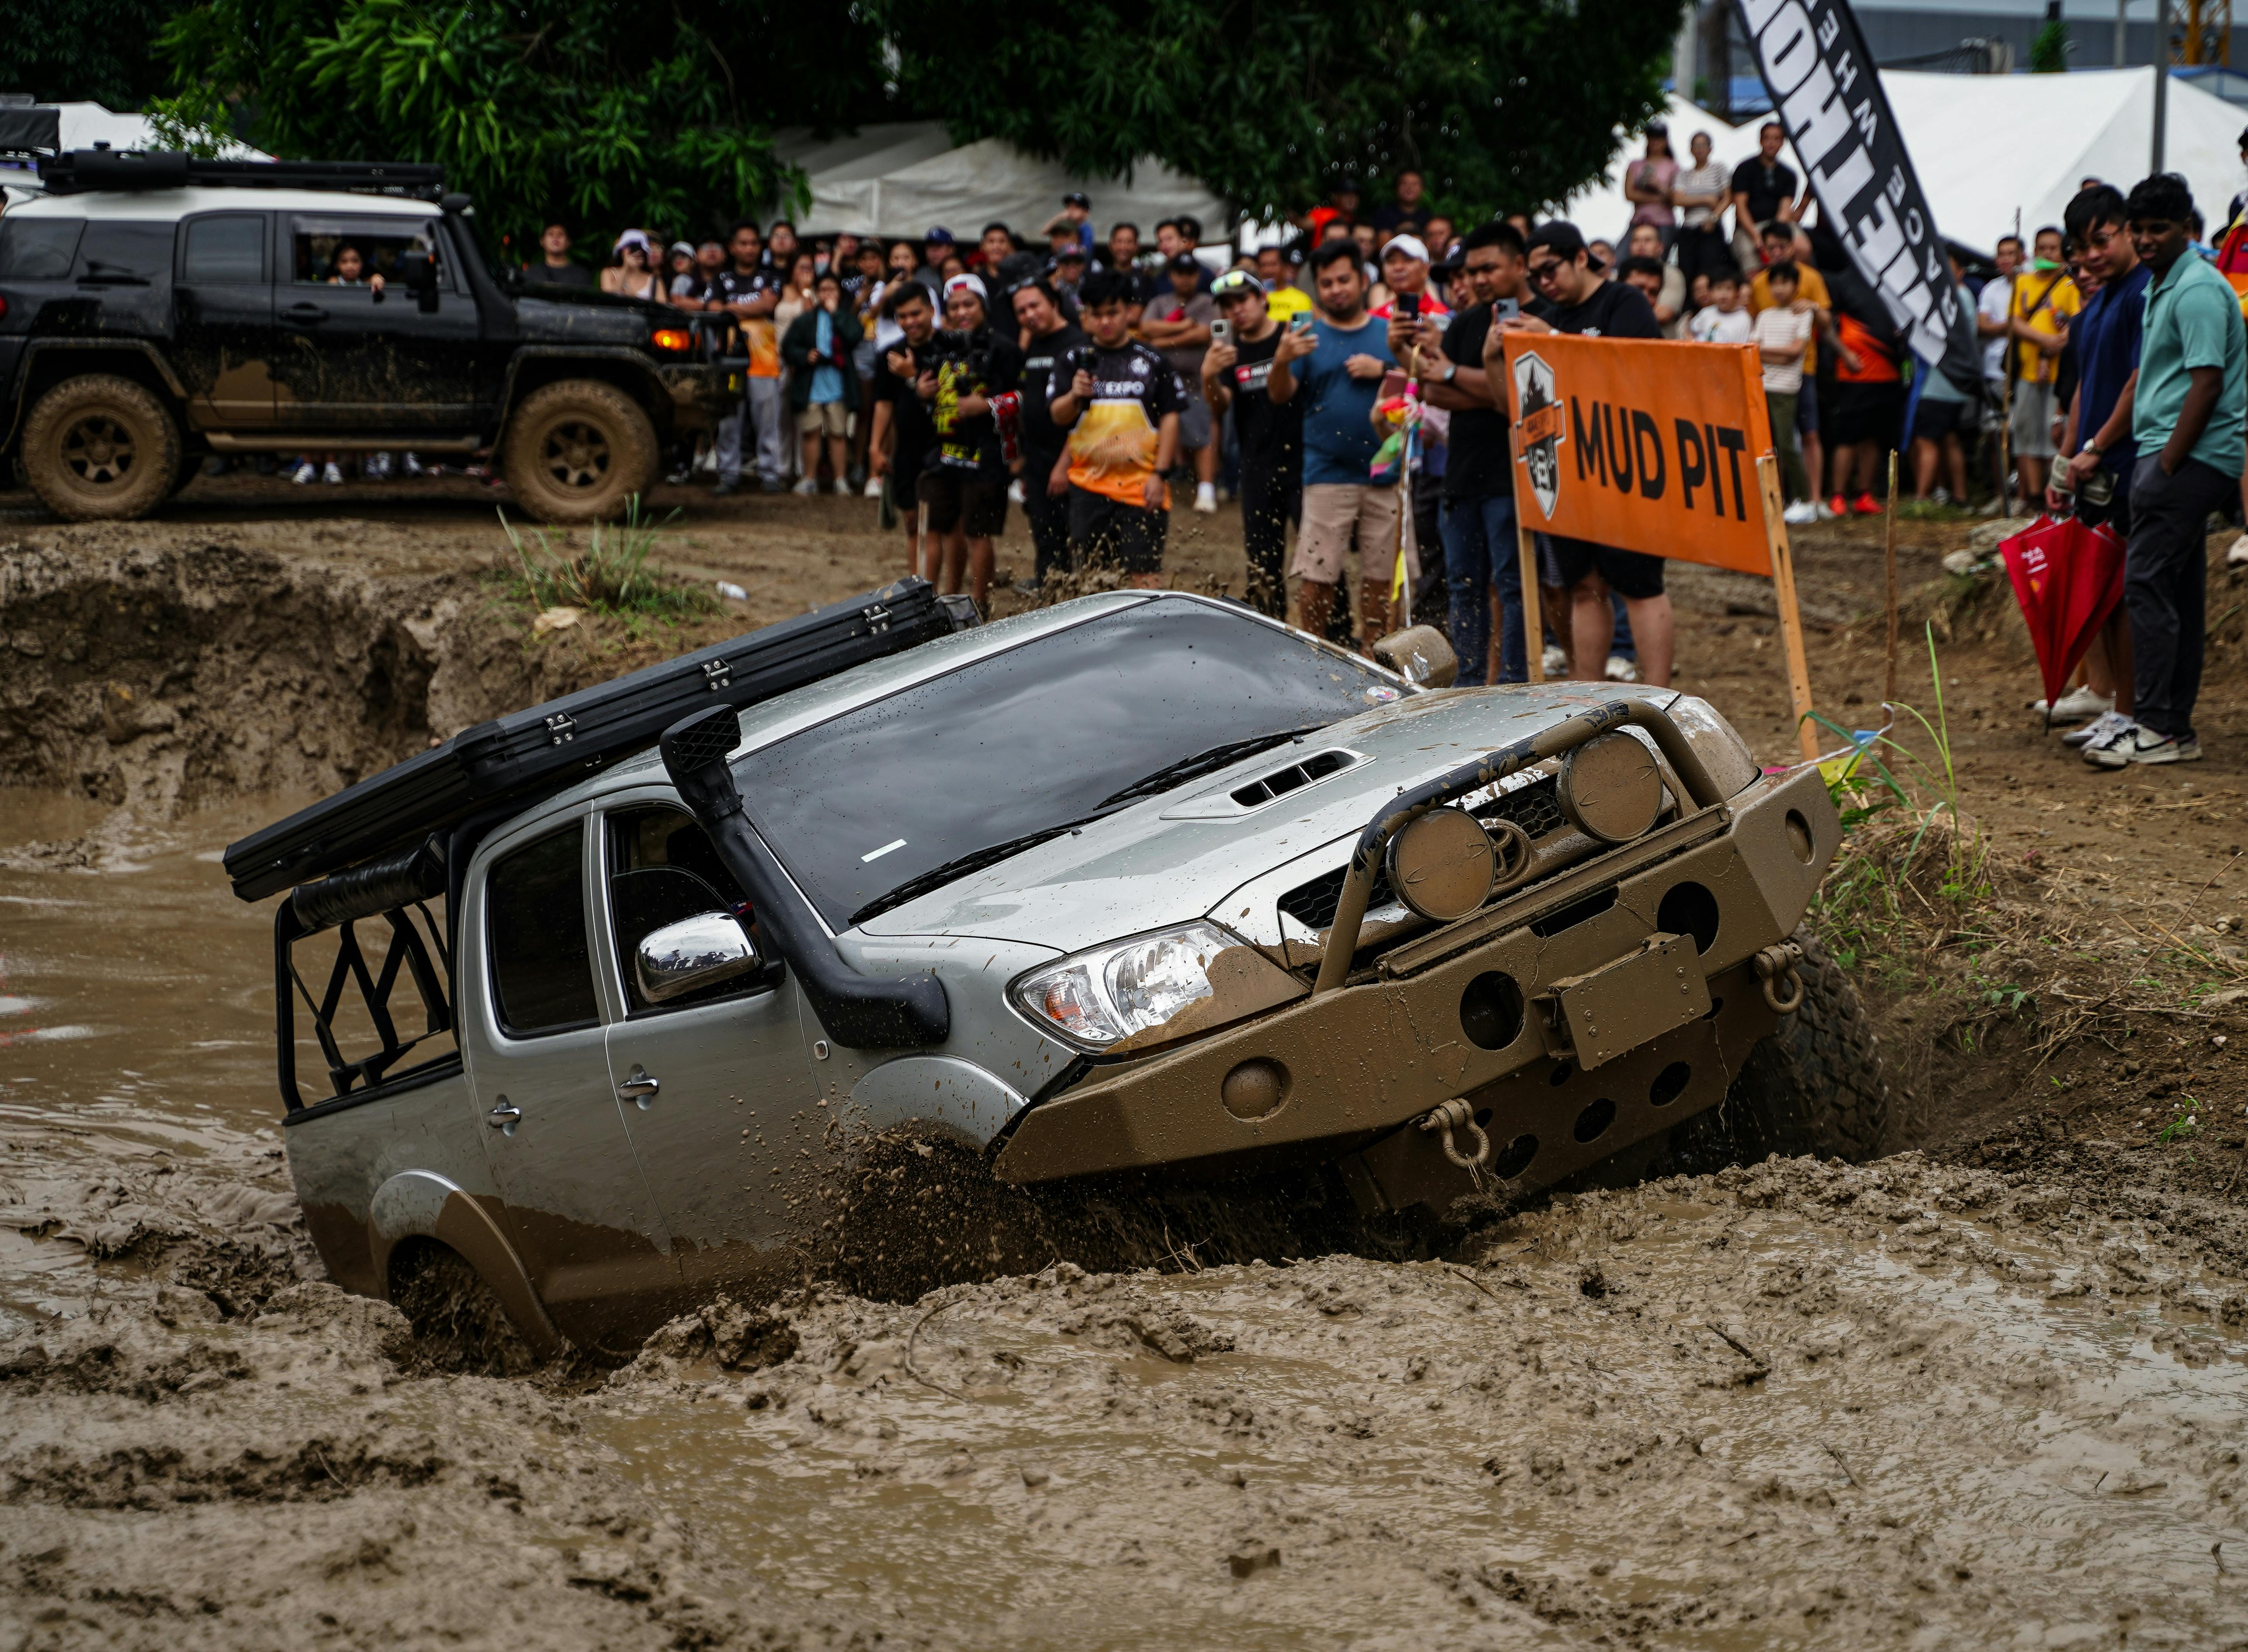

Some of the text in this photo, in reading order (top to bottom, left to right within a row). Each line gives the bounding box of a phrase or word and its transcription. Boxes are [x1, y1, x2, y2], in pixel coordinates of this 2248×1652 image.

[1807, 0, 1958, 327] RACE WHE
[1572, 395, 1746, 522] MUD PIT
